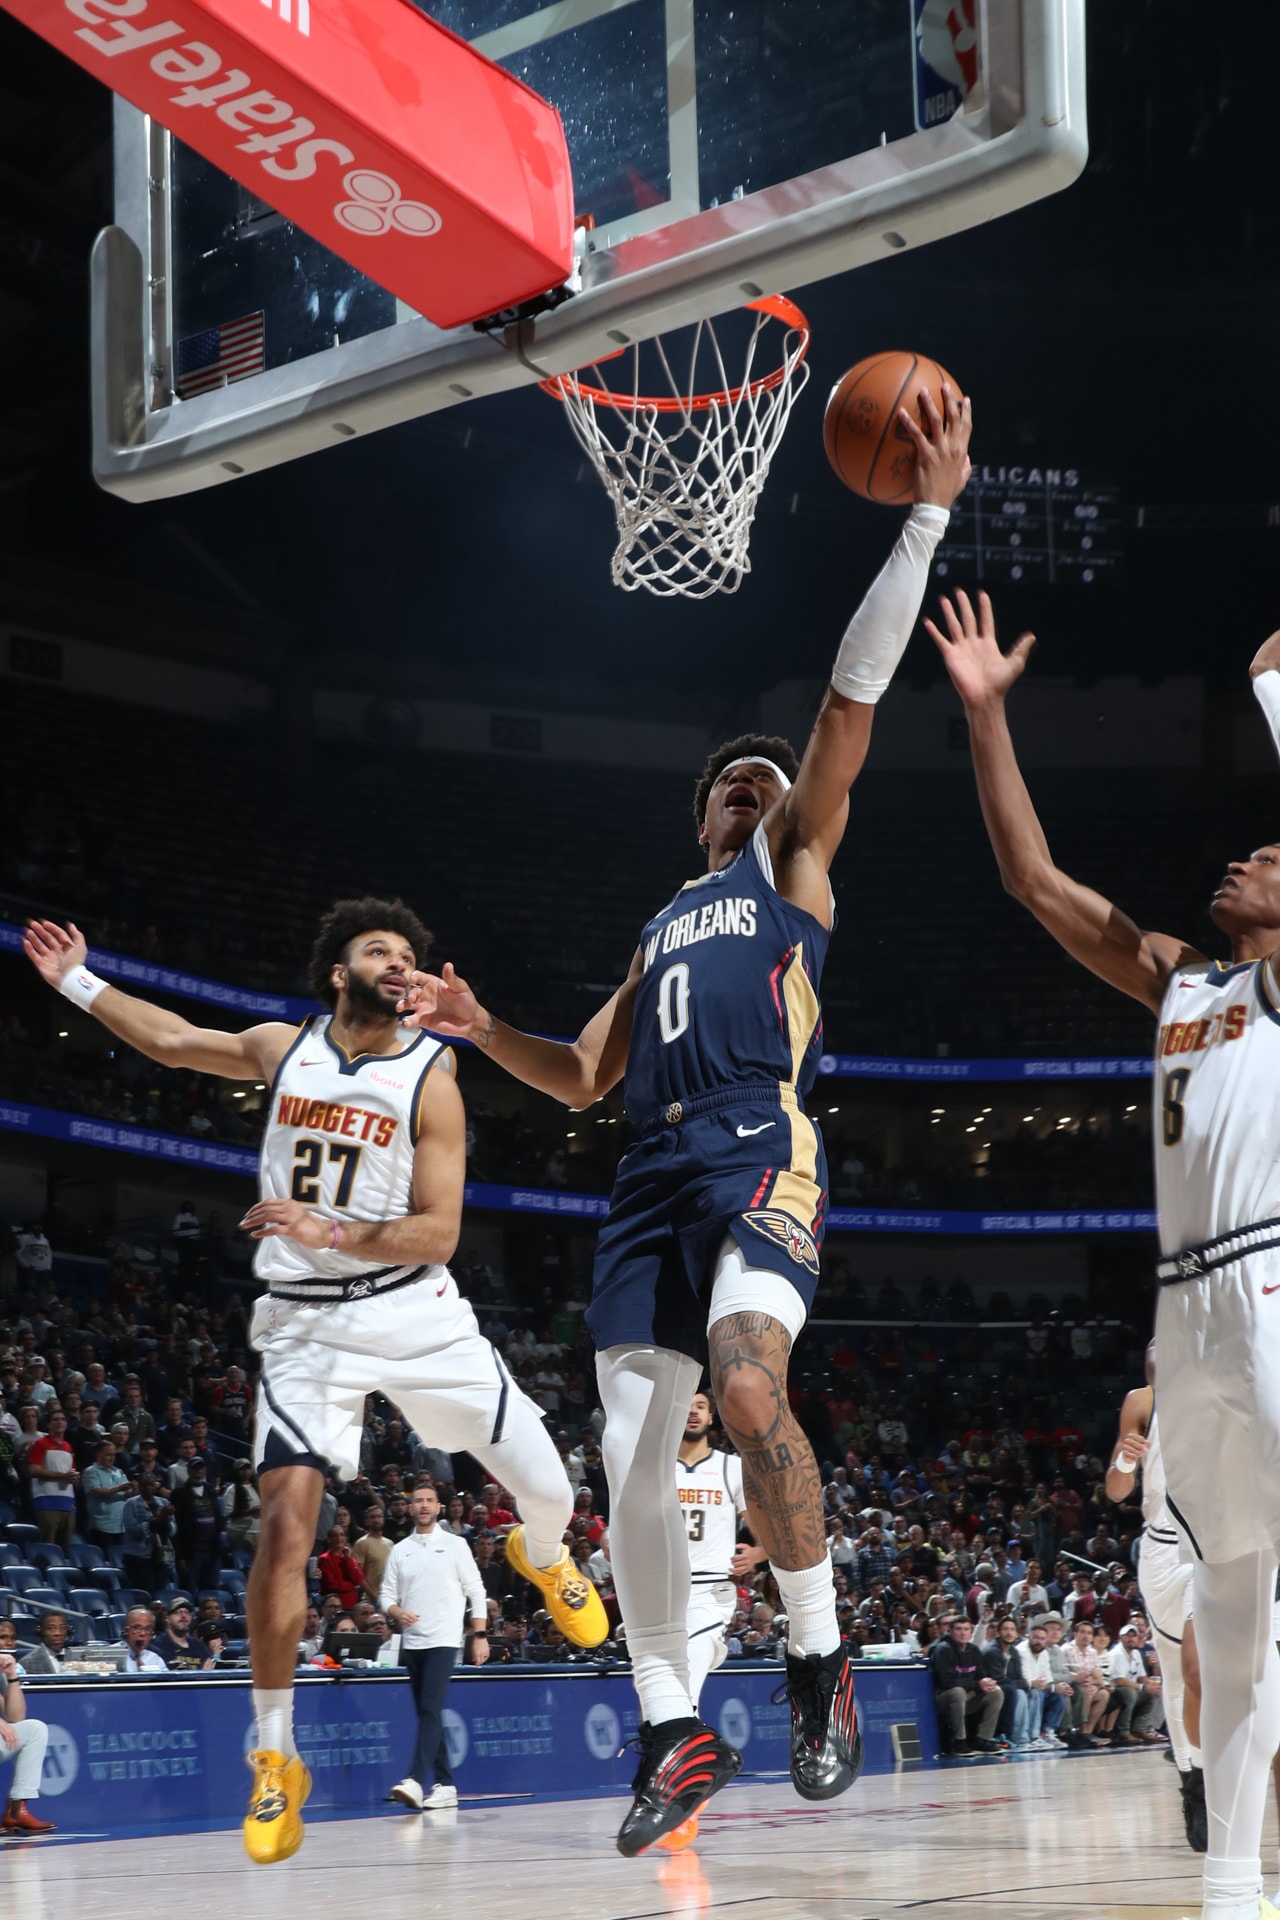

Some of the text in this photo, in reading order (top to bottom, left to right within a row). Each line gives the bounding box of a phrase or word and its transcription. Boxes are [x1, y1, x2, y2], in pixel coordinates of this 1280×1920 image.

[925, 89, 956, 124] NBA
[662, 898, 758, 954] ORLEANS
[657, 962, 690, 1044] 0
[1024, 1061, 1072, 1076] OFFICIAL
[1074, 1061, 1102, 1075] BANK
[1104, 1060, 1119, 1075] OF
[1120, 1060, 1140, 1074] THE
[70, 1120, 117, 1144] OFFICIAL
[277, 1094, 399, 1148] NUGGETS
[291, 1138, 363, 1209] 27
[982, 1217, 1032, 1230] OFFICIAL
[1034, 1216, 1064, 1229] BANK
[1066, 1215, 1081, 1228] OF
[1083, 1215, 1104, 1228] THE
[1106, 1214, 1130, 1227] NEW
[681, 1508, 706, 1542] 3
[296, 1721, 390, 1743] HANCOCK
[472, 1714, 552, 1735] HANCOCK
[87, 1730, 198, 1753] HANCOCK
[473, 1737, 553, 1758] WHITNEY
[87, 1756, 200, 1780] WHITNEY
